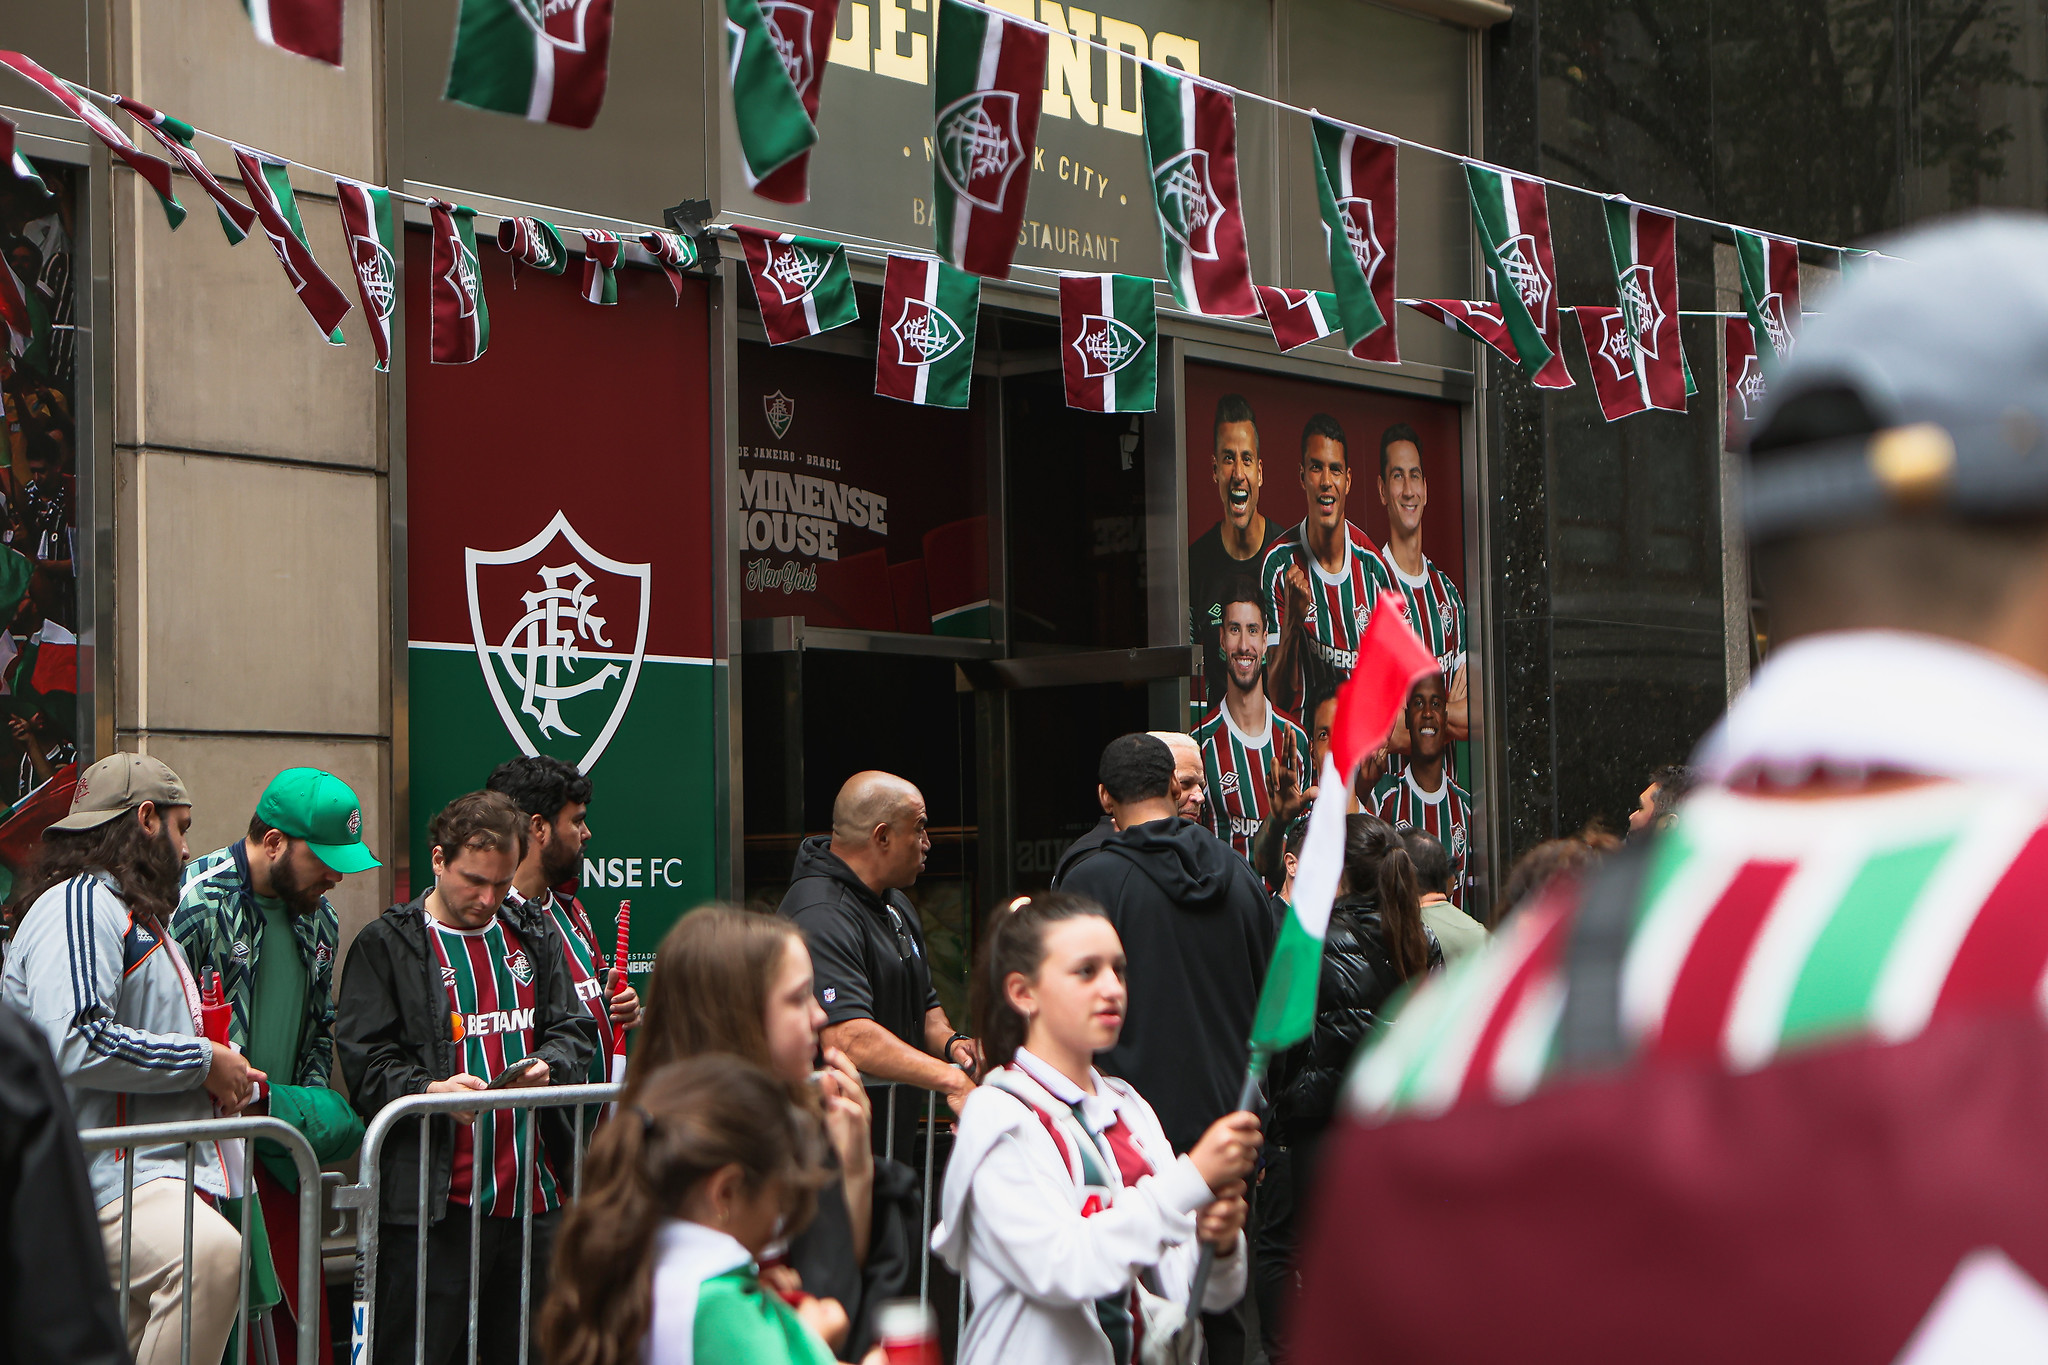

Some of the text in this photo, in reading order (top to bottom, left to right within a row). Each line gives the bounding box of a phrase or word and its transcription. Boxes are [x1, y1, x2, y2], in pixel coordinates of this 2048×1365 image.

[1058, 155, 1109, 199] CITY
[1018, 219, 1121, 264] STAURANT
[753, 447, 796, 462] JANEIRO
[806, 453, 842, 471] BRASIL
[739, 468, 888, 536] MINENSE
[746, 558, 818, 595] New York
[1308, 637, 1360, 669] SUPERB
[650, 857, 683, 888] FC
[627, 952, 657, 960] ESTADO
